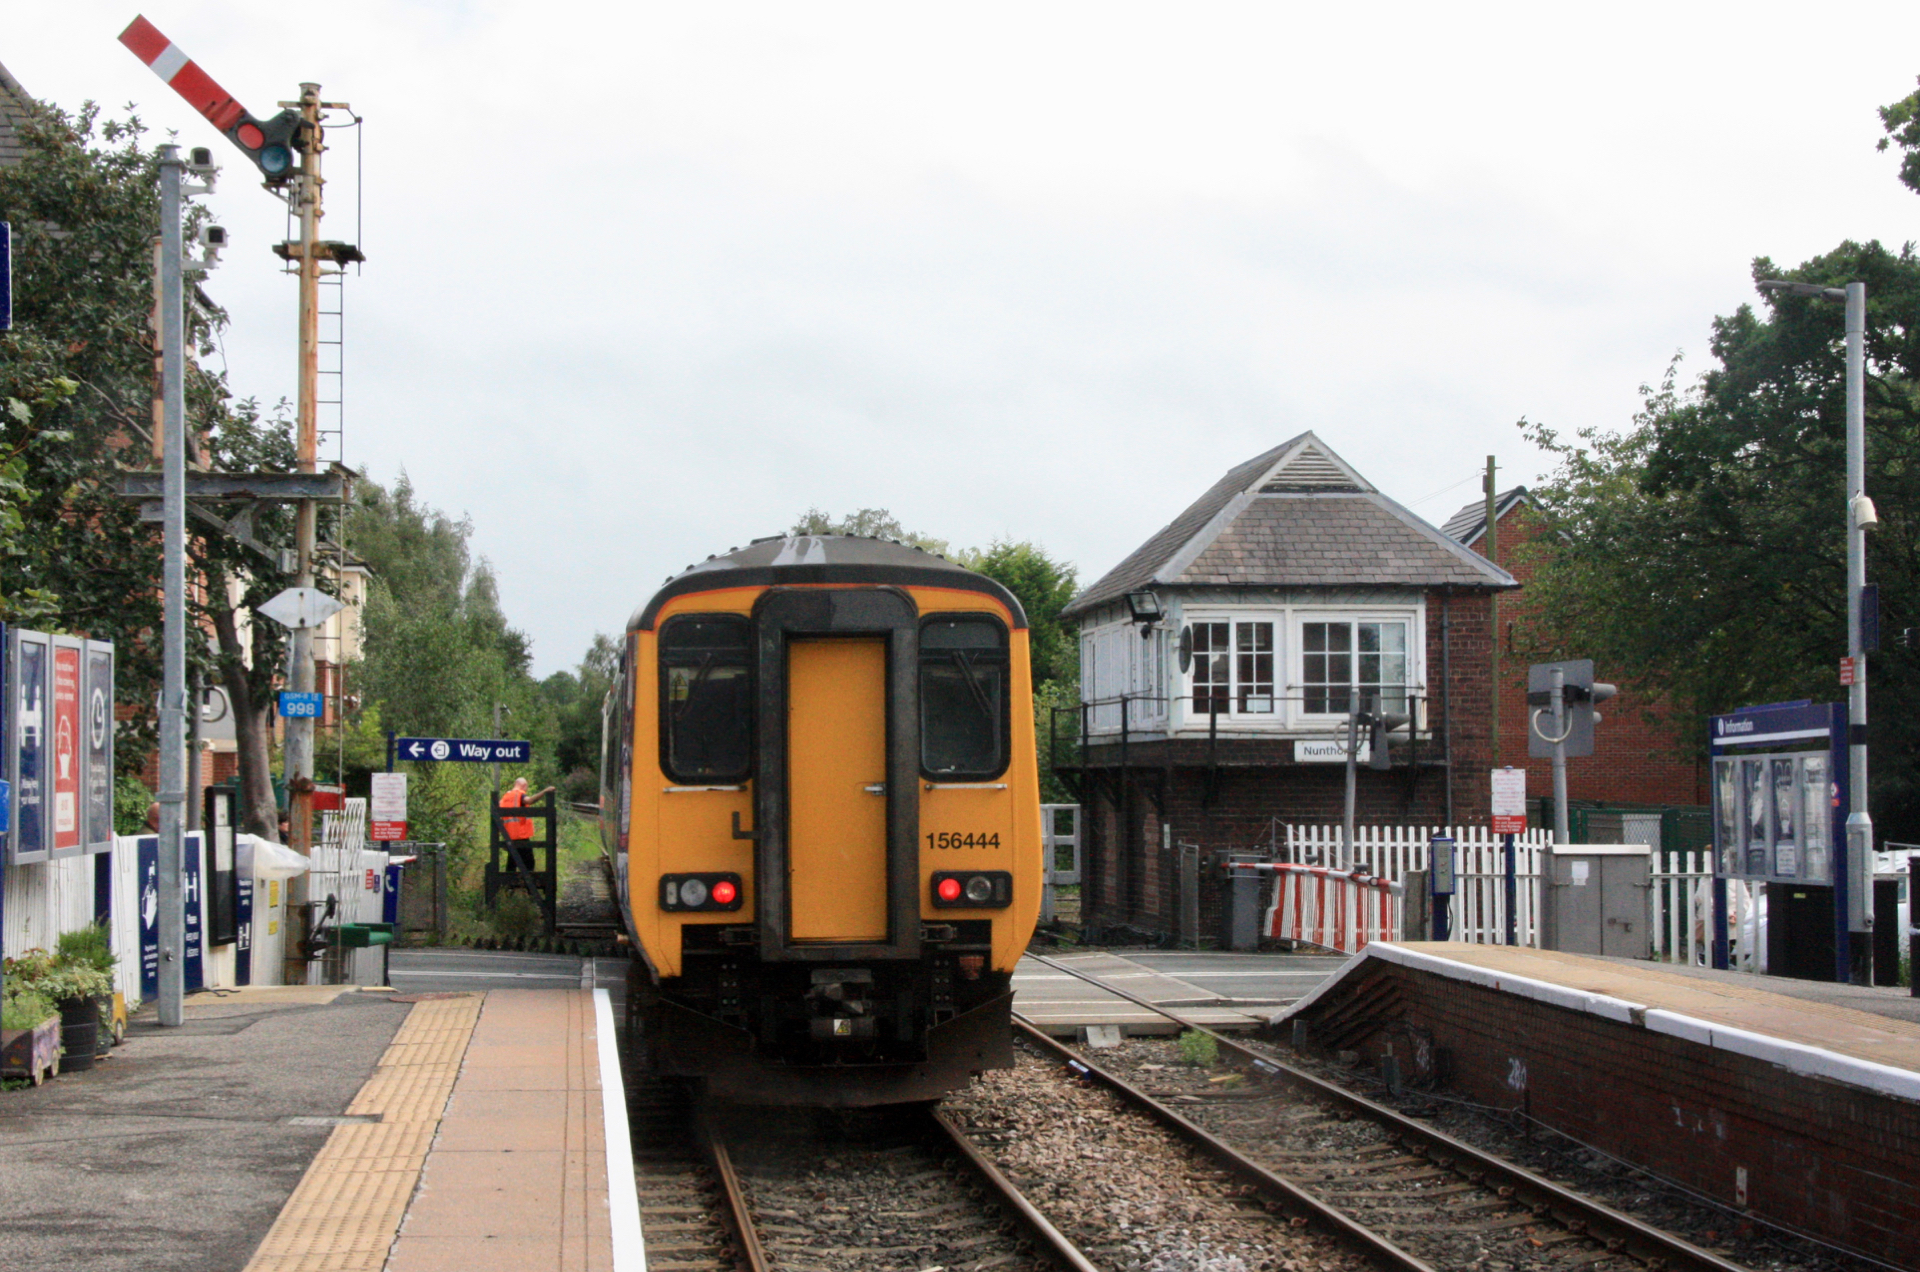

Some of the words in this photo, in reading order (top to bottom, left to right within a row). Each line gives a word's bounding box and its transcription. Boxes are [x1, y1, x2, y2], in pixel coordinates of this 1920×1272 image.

[286, 702, 315, 715] 998
[1725, 718, 1753, 733] Information
[459, 743, 491, 760] Way
[495, 746, 520, 757] out
[1303, 746, 1362, 756] Nunthoe
[926, 832, 1001, 849] 156444
